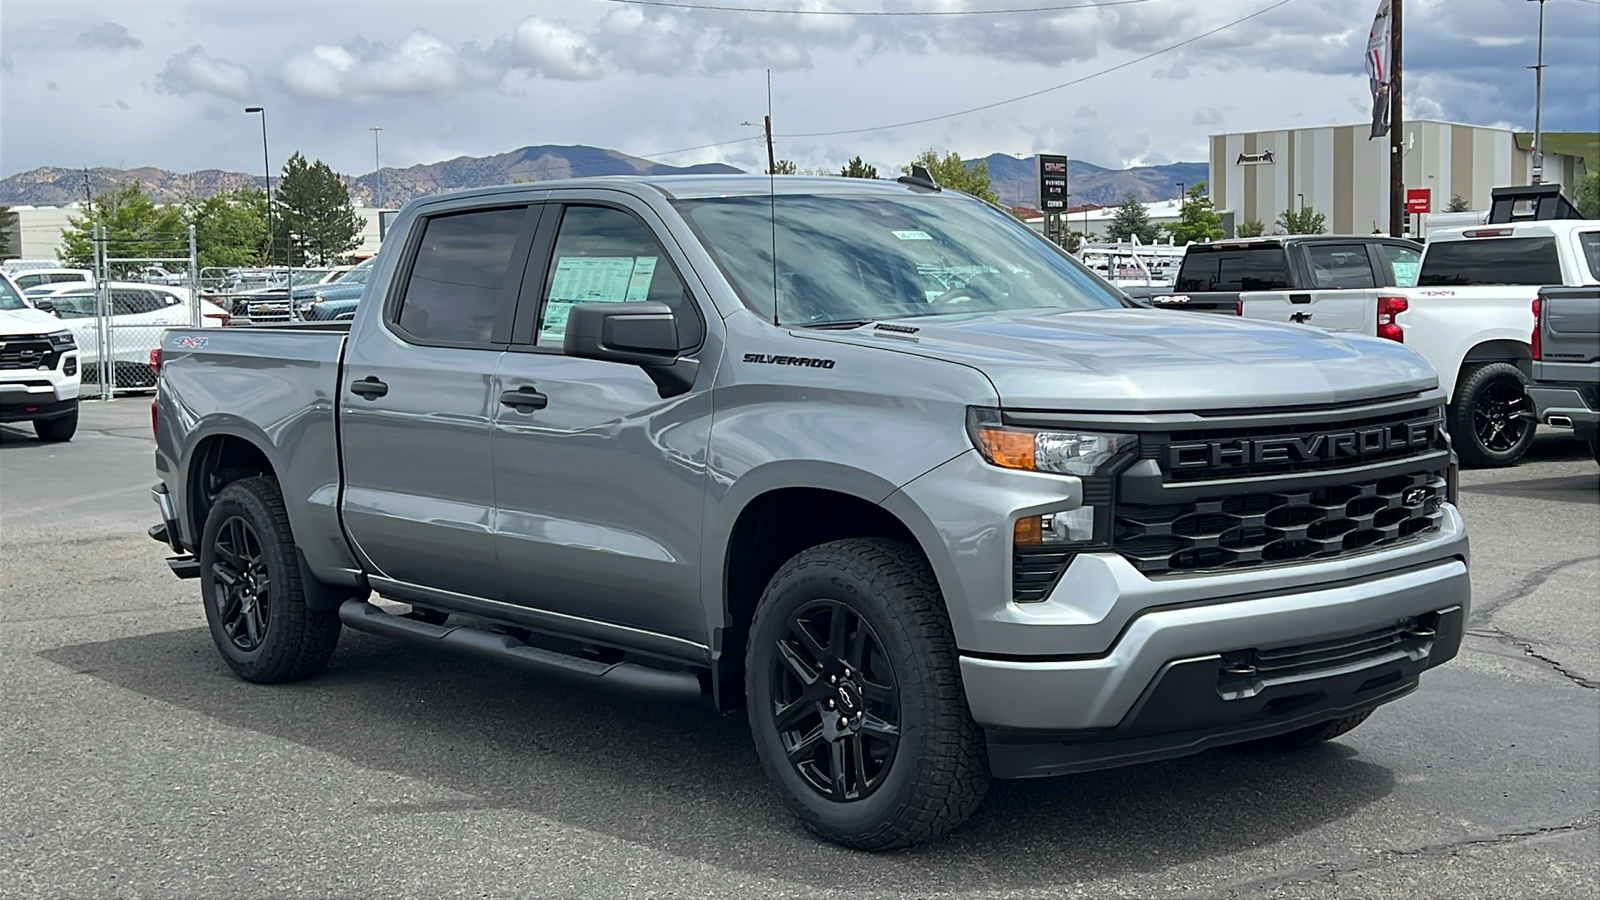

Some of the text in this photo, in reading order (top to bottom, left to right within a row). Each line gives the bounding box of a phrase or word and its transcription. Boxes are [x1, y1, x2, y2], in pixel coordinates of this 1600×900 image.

[1044, 162, 1066, 172] GMC
[743, 352, 836, 370] SILVERADO
[1166, 417, 1443, 469] CHEVROLET
